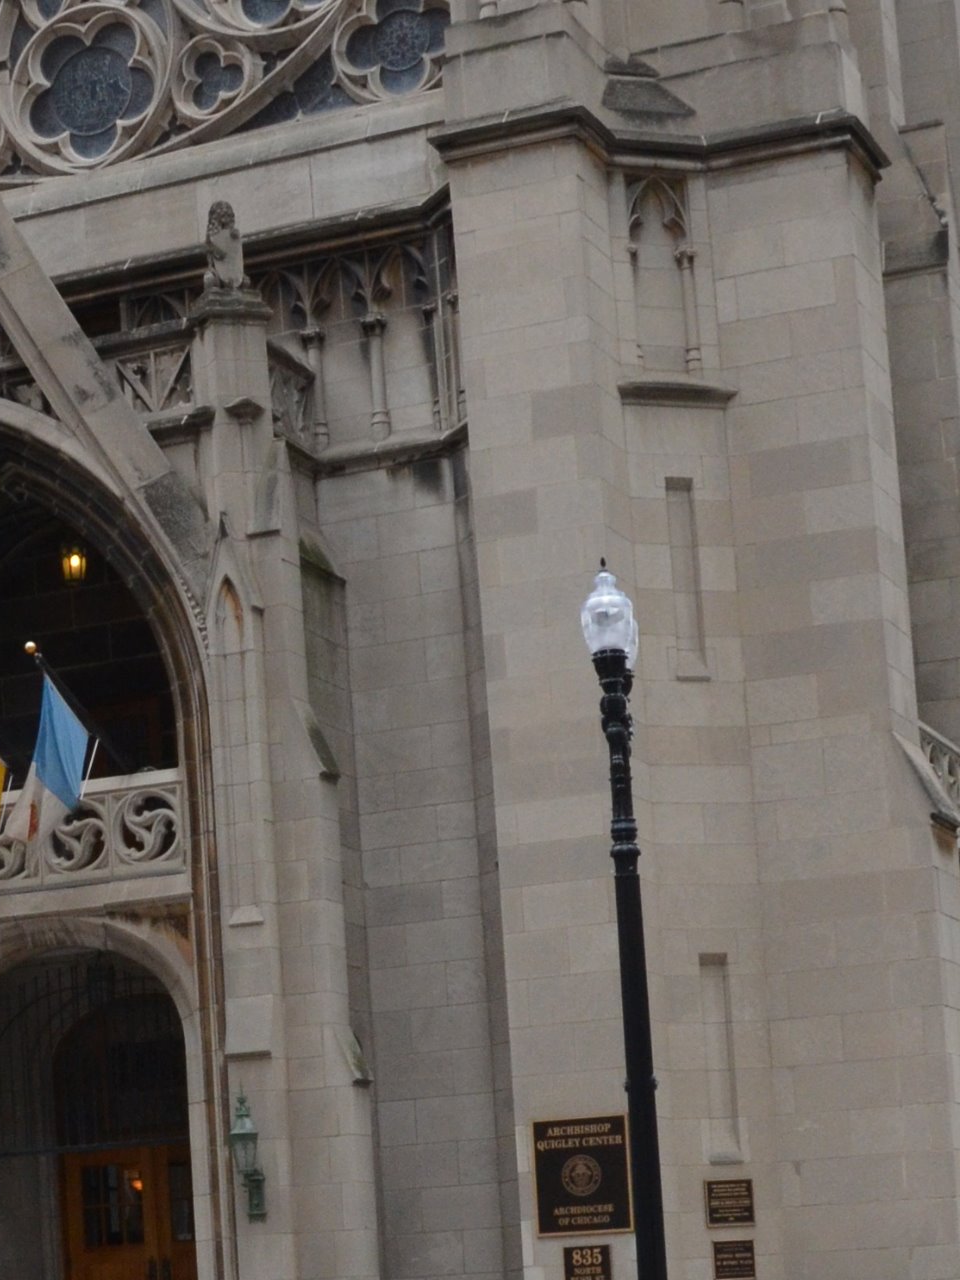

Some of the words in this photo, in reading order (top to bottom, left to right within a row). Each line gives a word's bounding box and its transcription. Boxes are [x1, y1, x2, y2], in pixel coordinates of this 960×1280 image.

[546, 1123, 611, 1137] ARCHBISHOP
[536, 1138, 580, 1152] QUIGLEY
[582, 1135, 623, 1147] CENTER
[553, 1203, 615, 1216] ARCHDIOCESE
[558, 1217, 569, 1226] OF
[571, 1214, 611, 1225] CHICAGO
[572, 1248, 602, 1266] 835
[573, 1266, 603, 1275] NORTH
